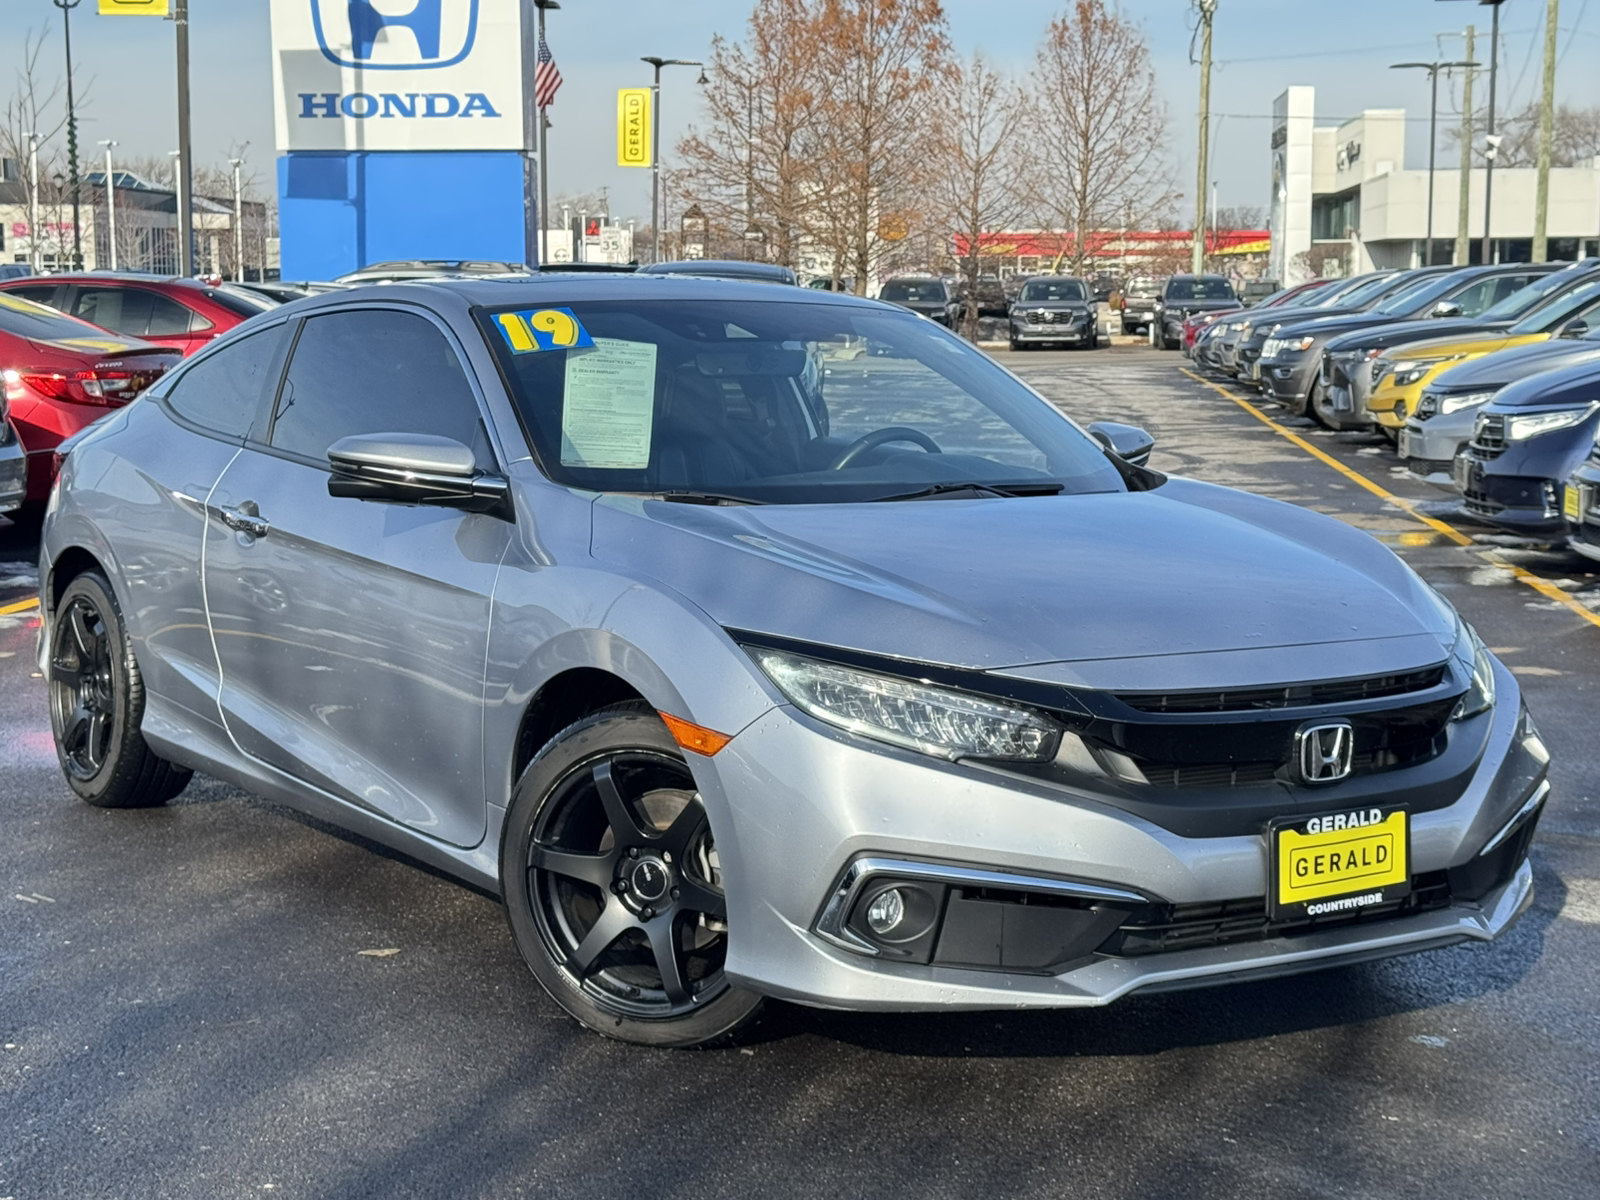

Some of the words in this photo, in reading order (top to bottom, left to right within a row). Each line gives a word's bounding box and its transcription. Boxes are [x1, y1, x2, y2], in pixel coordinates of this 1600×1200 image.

[298, 92, 502, 119] HONDA
[629, 98, 640, 156] GERALD
[602, 240, 619, 250] 35
[498, 309, 580, 352] 19
[1306, 808, 1382, 834] GERALD
[1295, 844, 1388, 877] GERALD
[1307, 892, 1383, 916] COUNTRYSIDE
